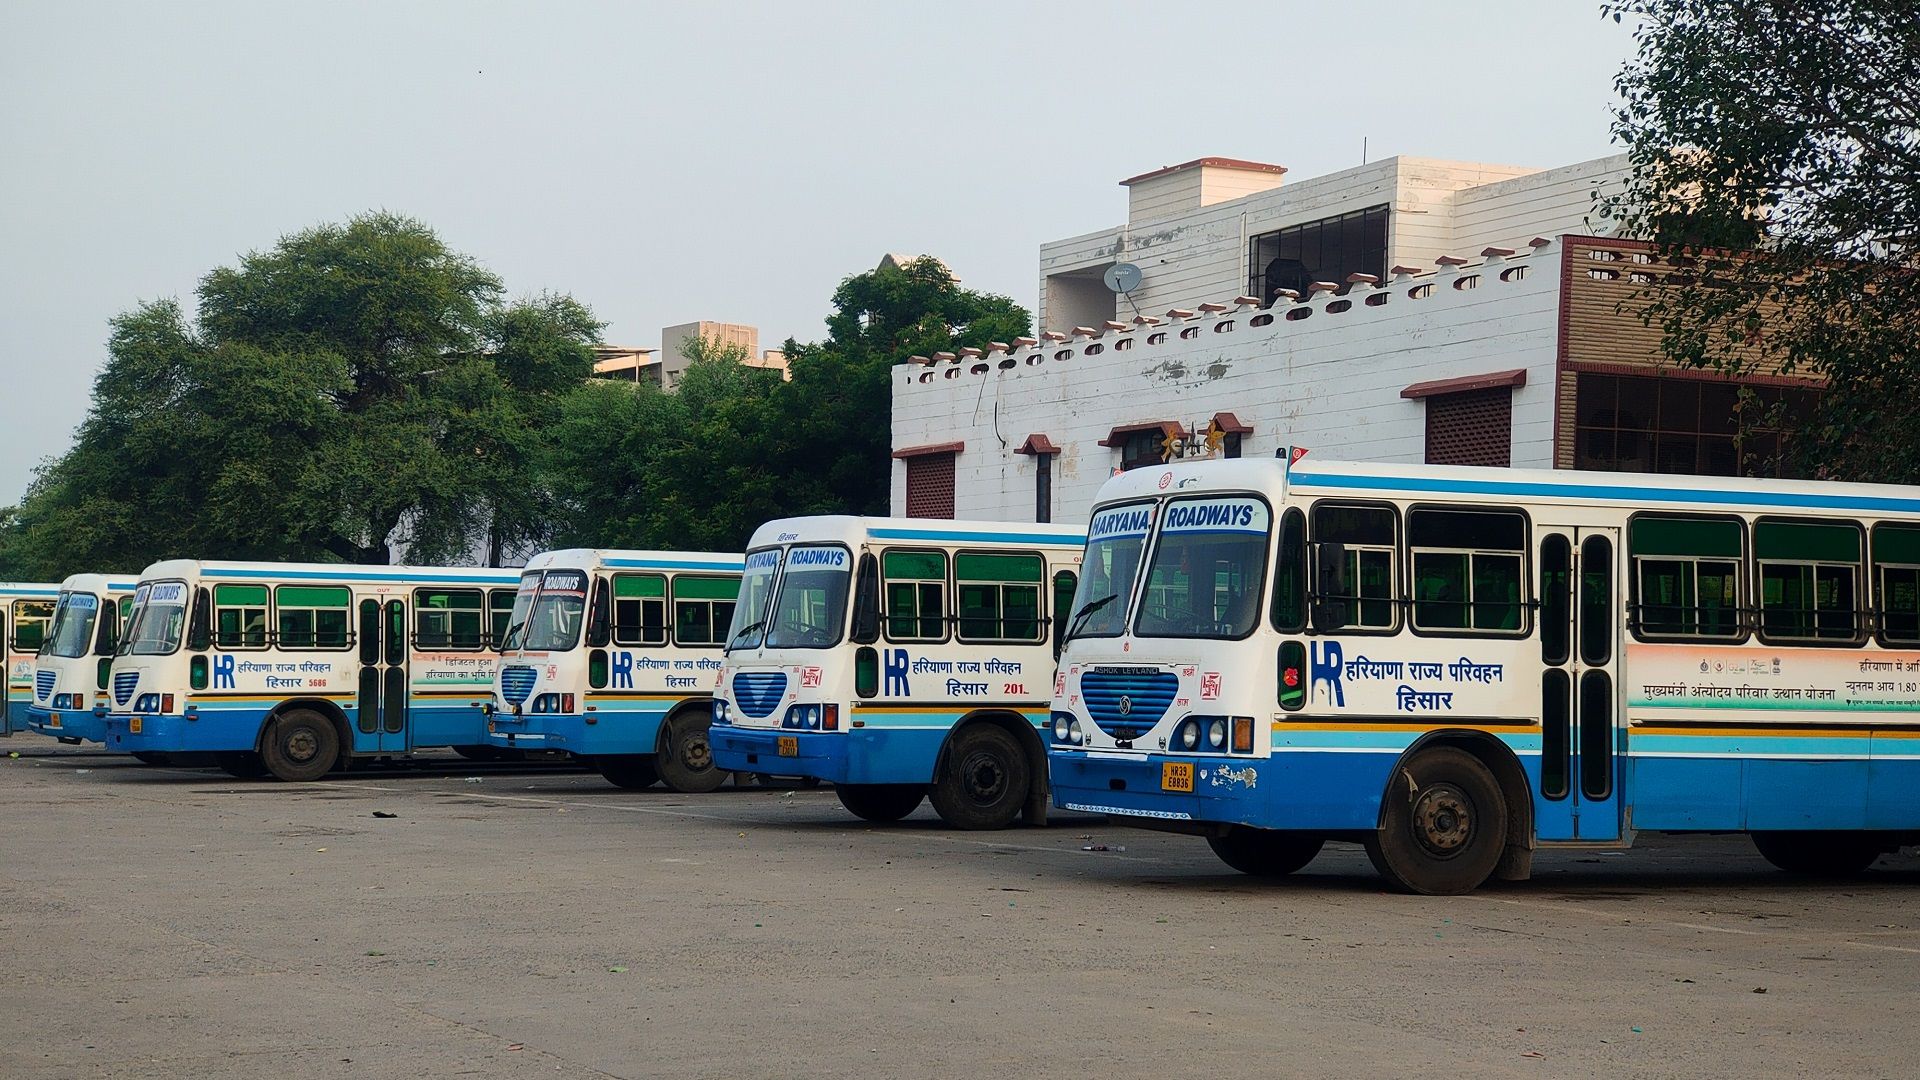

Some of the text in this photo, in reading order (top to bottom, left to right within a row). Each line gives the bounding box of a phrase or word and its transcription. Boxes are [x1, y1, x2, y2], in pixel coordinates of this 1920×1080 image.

[1091, 505, 1253, 537] HARYANA ROADWAYS
[791, 550, 844, 566] ROADWAYS
[543, 576, 580, 590] ROADWAYS
[151, 585, 180, 600] ROADWAYS
[238, 660, 331, 673] हरियाणा राज्य परिवहन
[445, 656, 492, 668] डिजिटल हुआ
[611, 651, 633, 688] HR
[636, 656, 721, 672] हरियाणा राज्य परिवह
[912, 656, 1021, 675] हरियाणा राज्य परिवहन
[1345, 655, 1503, 684] हरियाणा राज्य परिवहन
[1859, 658, 1893, 673] हरियाणा
[213, 654, 235, 689] HR
[425, 669, 455, 679] हरियाणा
[884, 648, 911, 697] HR
[1122, 667, 1158, 675] LEYLAND
[1310, 640, 1345, 708] HR
[266, 675, 301, 688] हिसार
[309, 678, 327, 687] 5686
[665, 675, 697, 688] हिसार
[946, 678, 988, 696] हिसार
[1845, 681, 1917, 695] न्यूनतम आय 1.80
[1396, 684, 1453, 712] हिसार
[1643, 682, 1835, 700] मुख्यमंत्री अंत्योदय परिवार उत्थान योजना
[1170, 766, 1187, 777] HR39
